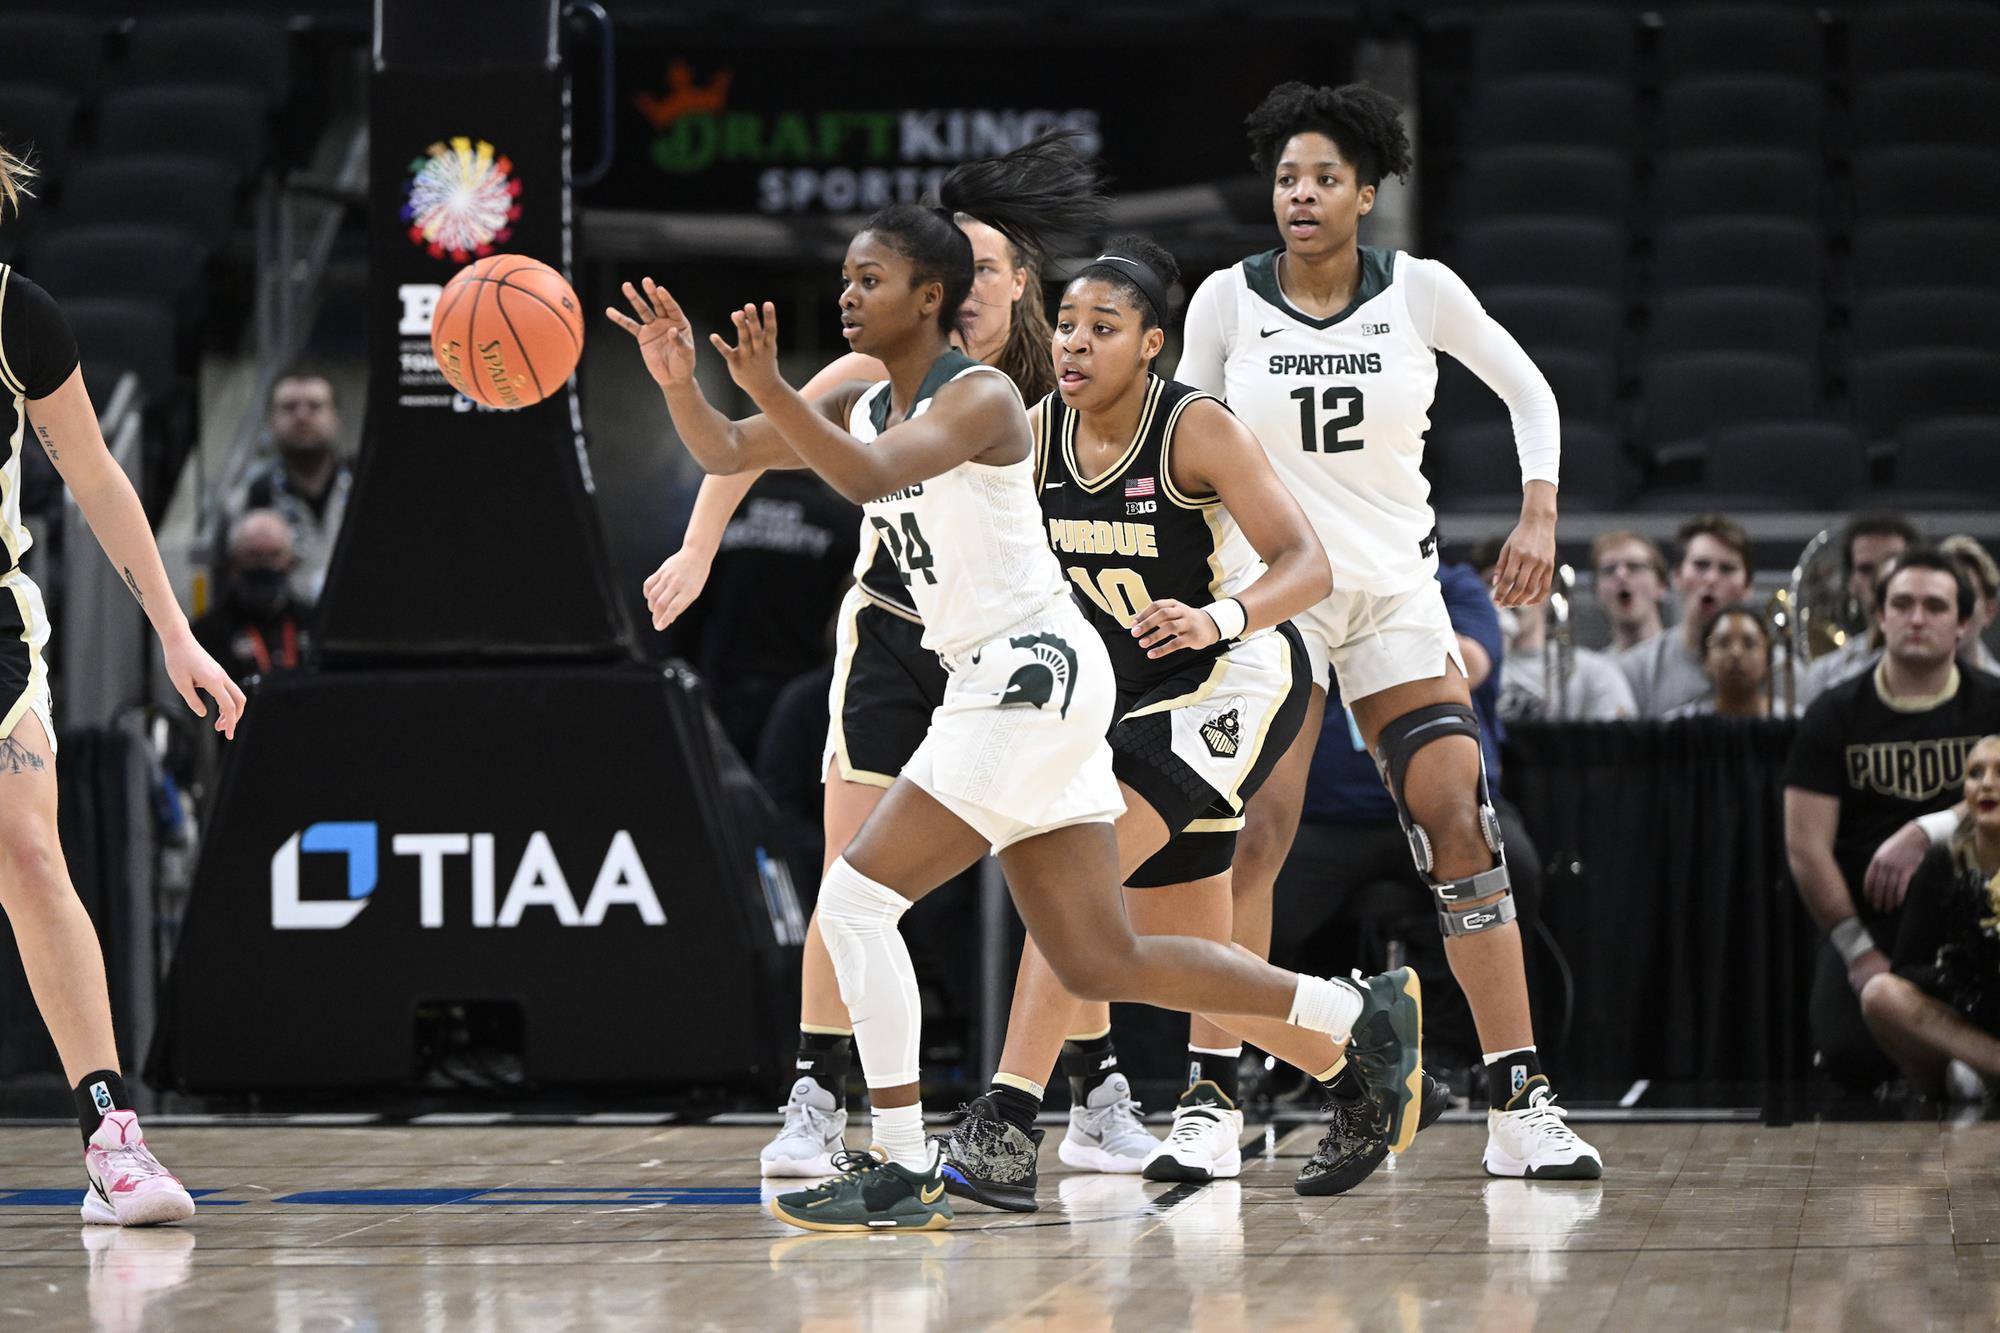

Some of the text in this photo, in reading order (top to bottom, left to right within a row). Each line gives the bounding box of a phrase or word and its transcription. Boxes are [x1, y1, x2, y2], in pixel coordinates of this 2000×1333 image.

[1269, 353, 1382, 375] SPARTANS
[1290, 386, 1364, 453] 12
[870, 512, 938, 586] 24
[1048, 518, 1159, 558] PURDUE
[1066, 566, 1154, 629] 10
[1203, 725, 1237, 754] PURDUE
[393, 829, 668, 928] TIAA
